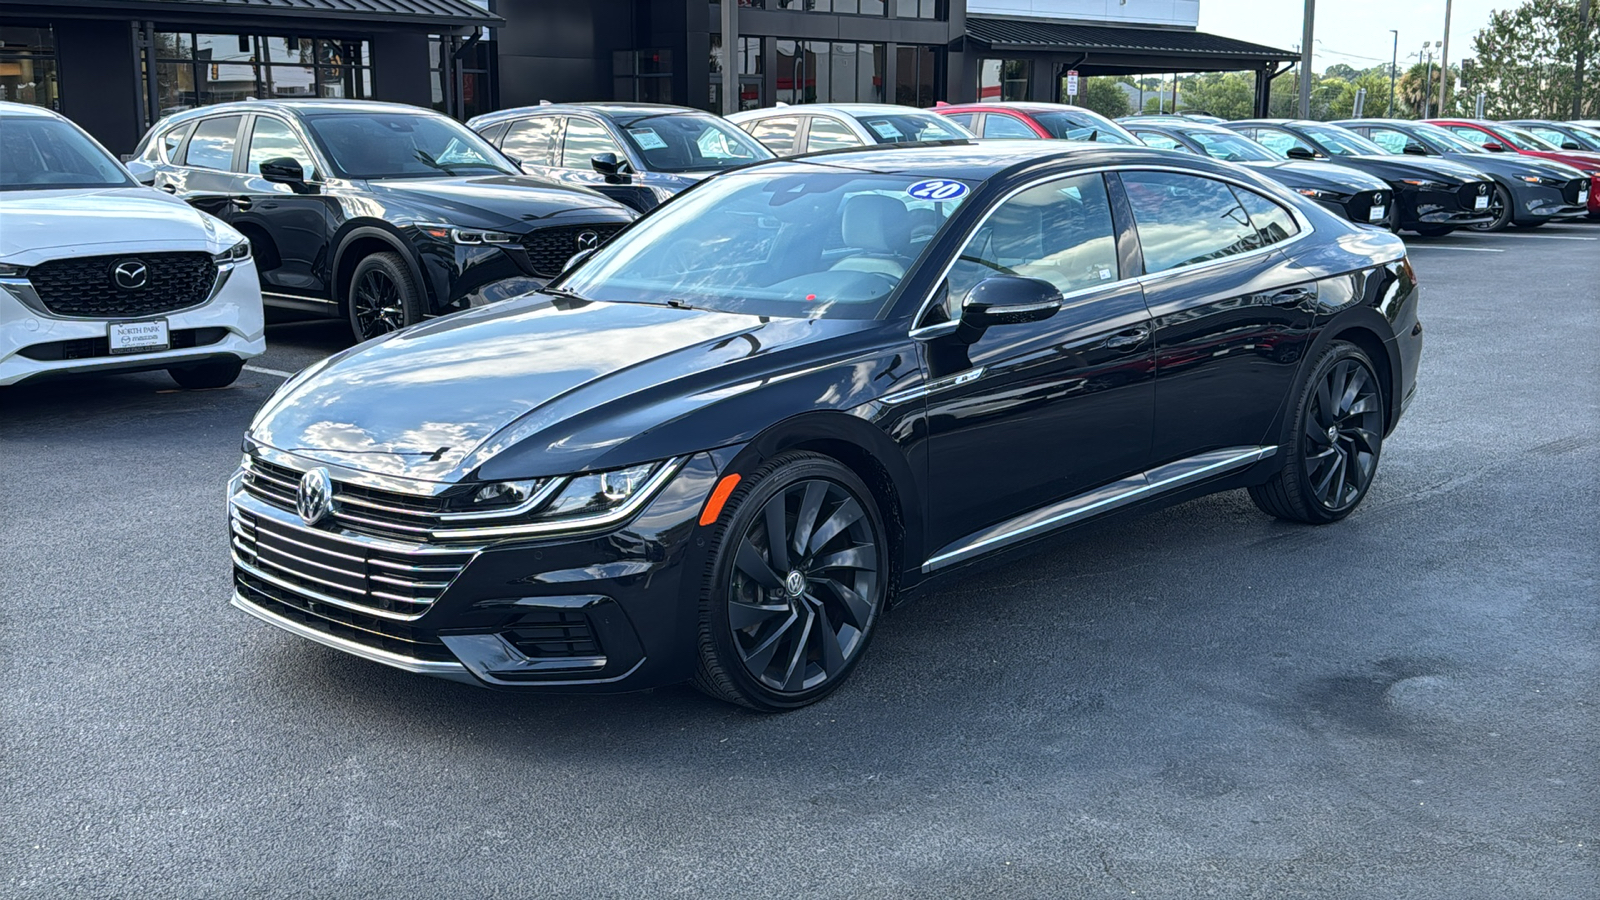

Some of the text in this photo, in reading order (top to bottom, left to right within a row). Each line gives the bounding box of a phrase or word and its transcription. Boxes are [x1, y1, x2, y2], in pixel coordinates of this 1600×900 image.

[913, 181, 961, 199] 20
[117, 325, 160, 335] NORTH PARK
